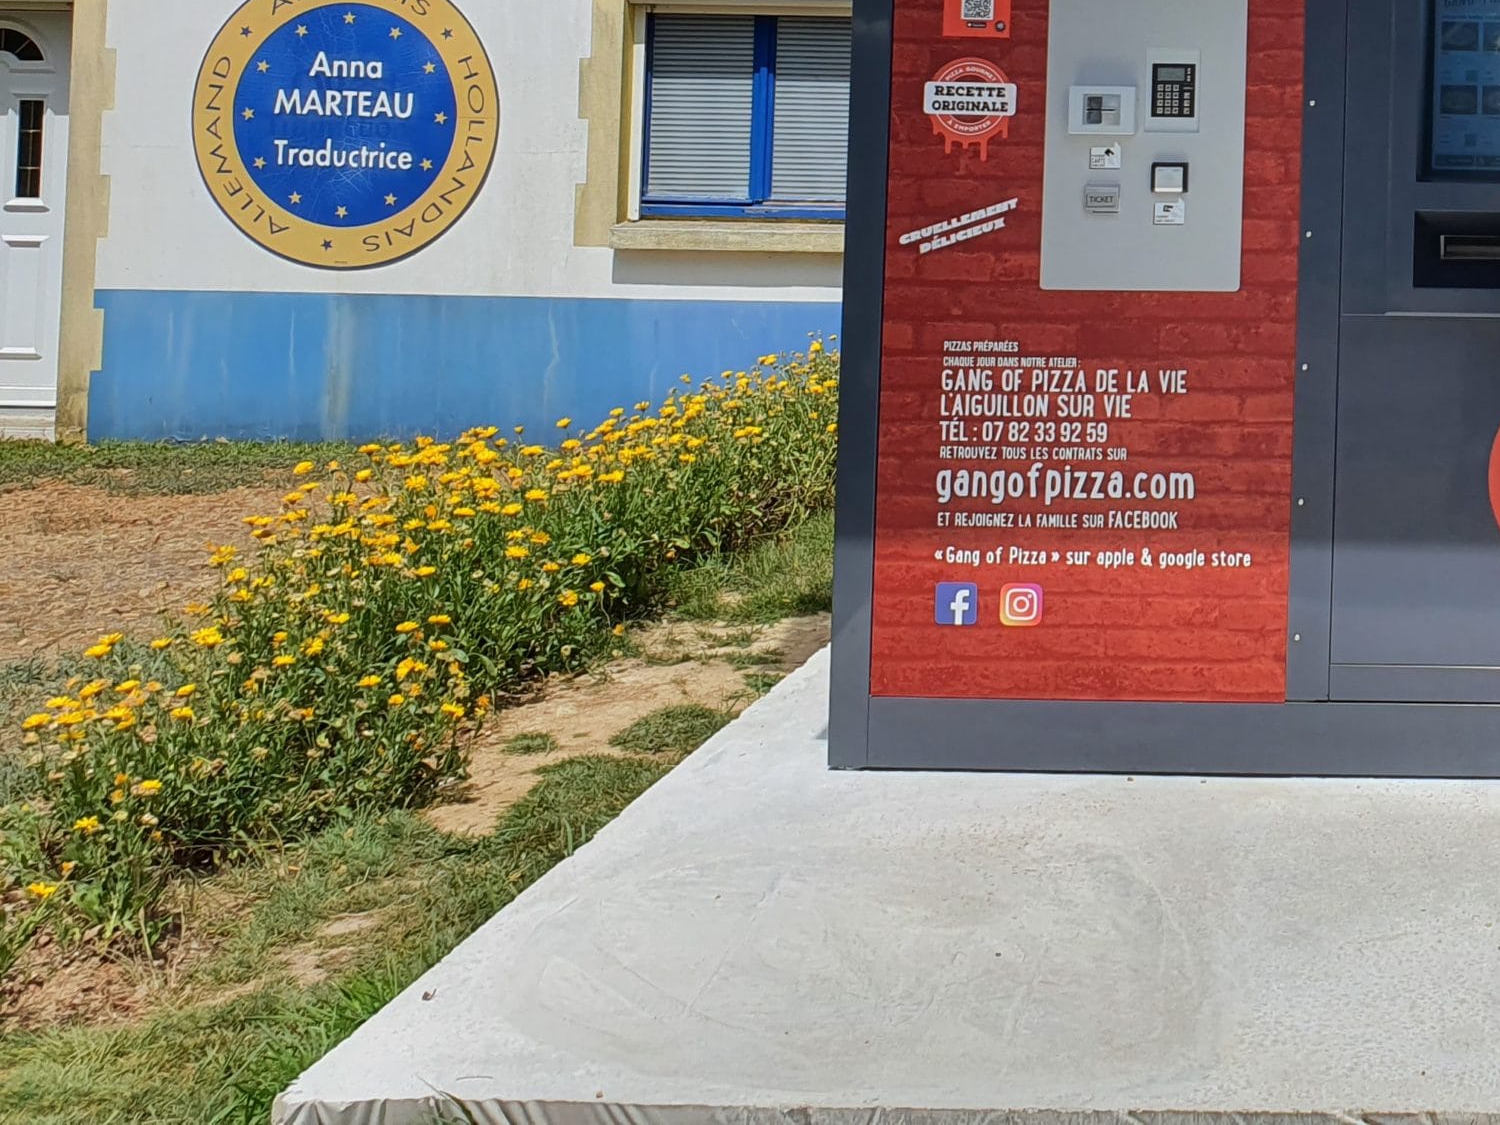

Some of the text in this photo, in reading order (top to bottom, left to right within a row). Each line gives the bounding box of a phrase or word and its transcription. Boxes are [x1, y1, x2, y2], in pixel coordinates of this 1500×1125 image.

[309, 51, 383, 79] Anna
[273, 88, 414, 119] MARTEAU
[934, 85, 1006, 98] RECETTE
[931, 100, 1009, 113] ORIGINALE
[206, 56, 290, 235] ALLEMAND
[273, 138, 414, 170] Traductrice
[361, 55, 486, 253] HOLLANDAIS
[1090, 195, 1114, 204] TICKET
[899, 197, 1019, 245] CRUELLEMENT
[919, 217, 1006, 254] DÉLICIEUX
[943, 340, 1019, 352] PIZZAS PRÉPARÉES
[943, 356, 974, 367] CHAQUE
[976, 357, 996, 367] JOUR
[997, 357, 1019, 367] DANS
[1020, 357, 1046, 368] NOTRE
[941, 368, 1188, 394] GANG OF PIZZA DE LA VIE
[940, 392, 1132, 418] L'AIGUILLON SUR VIE
[982, 421, 1004, 442] 07
[1008, 421, 1030, 442] 82
[1034, 422, 1056, 443] 33
[1060, 422, 1081, 443] 92
[1086, 422, 1108, 443] 59
[939, 446, 1127, 461] RETROUVEZ TOUS LES CONTRATS SUR
[936, 462, 1195, 506] gangofpizza.com
[937, 511, 1178, 529] ET REJOIGNEZ LA FAMILLE SUR FACEBOOK
[986, 546, 1003, 565] of
[1066, 550, 1091, 565] sur
[1096, 547, 1134, 568] apple
[1140, 547, 1152, 566] &
[1159, 548, 1205, 569] google
[1211, 550, 1251, 567] store
